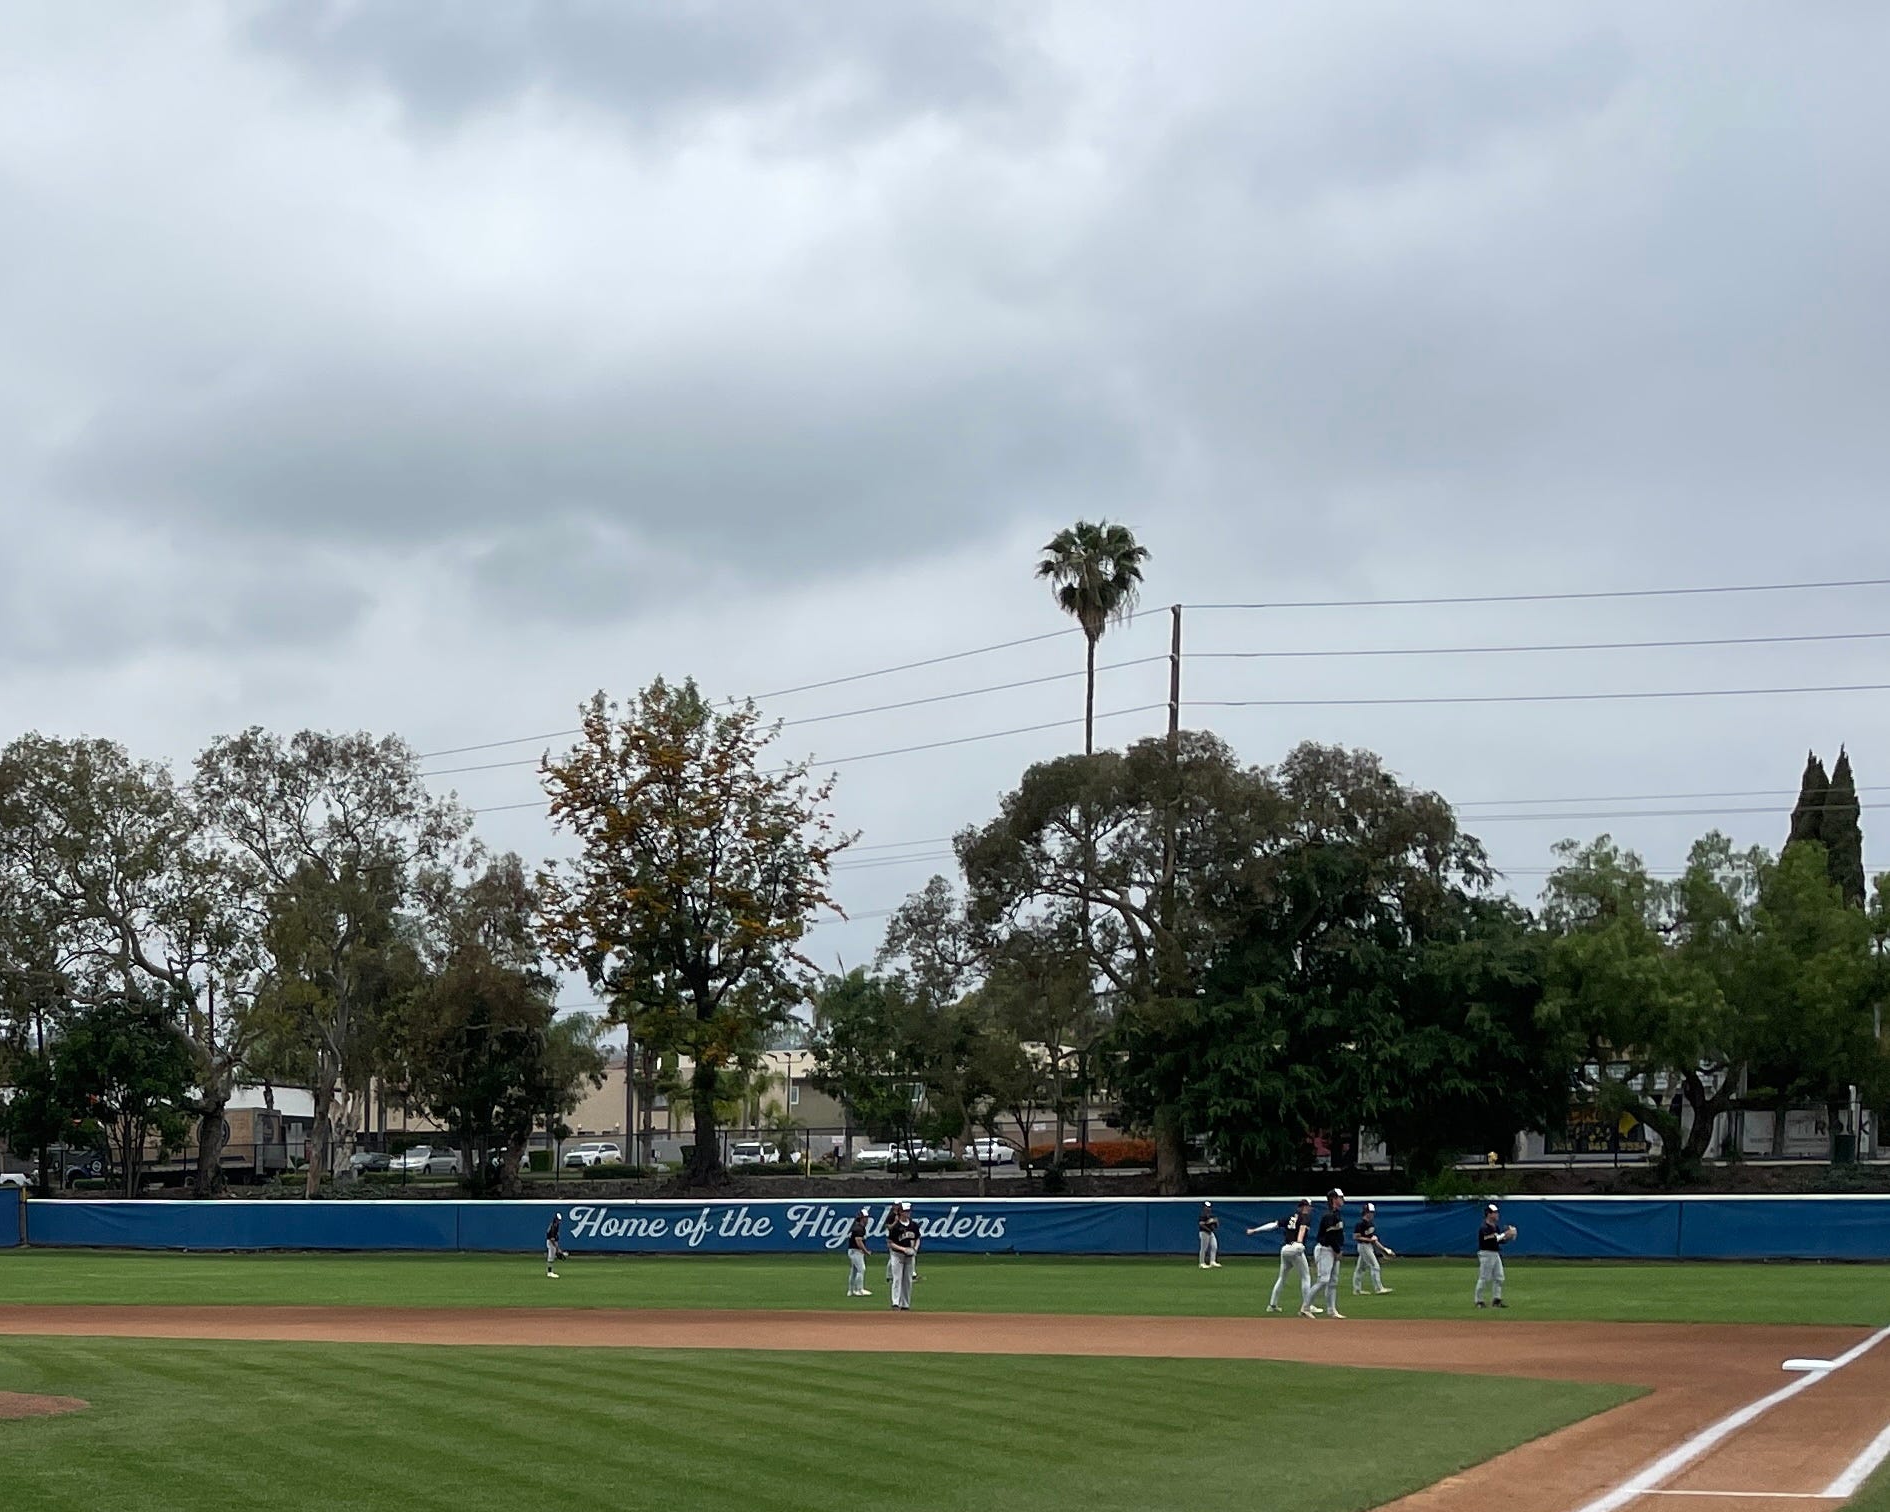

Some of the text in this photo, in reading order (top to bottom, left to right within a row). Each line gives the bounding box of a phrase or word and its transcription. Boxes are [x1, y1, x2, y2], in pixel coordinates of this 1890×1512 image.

[568, 1204, 1007, 1249] Home of the Highlnders
